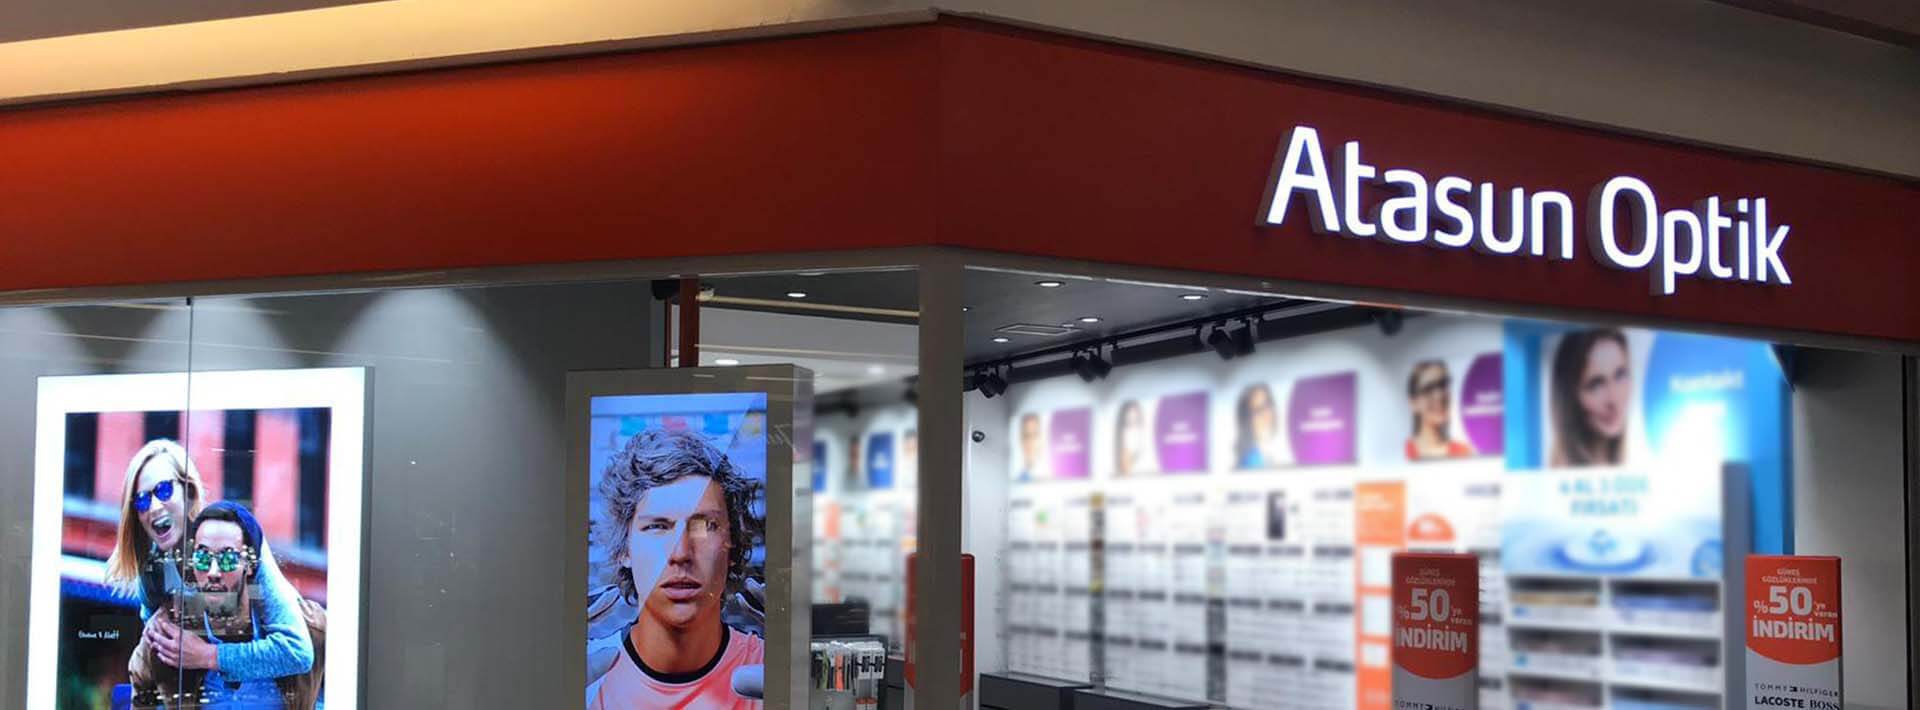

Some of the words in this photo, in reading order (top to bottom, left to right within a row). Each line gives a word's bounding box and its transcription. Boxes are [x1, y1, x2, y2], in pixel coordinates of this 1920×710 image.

[1266, 125, 1575, 260] Atasun
[1599, 175, 1793, 295] Optik
[1752, 615, 1835, 643] İNDİRİM
[1754, 695, 1804, 709] LACOSTE
